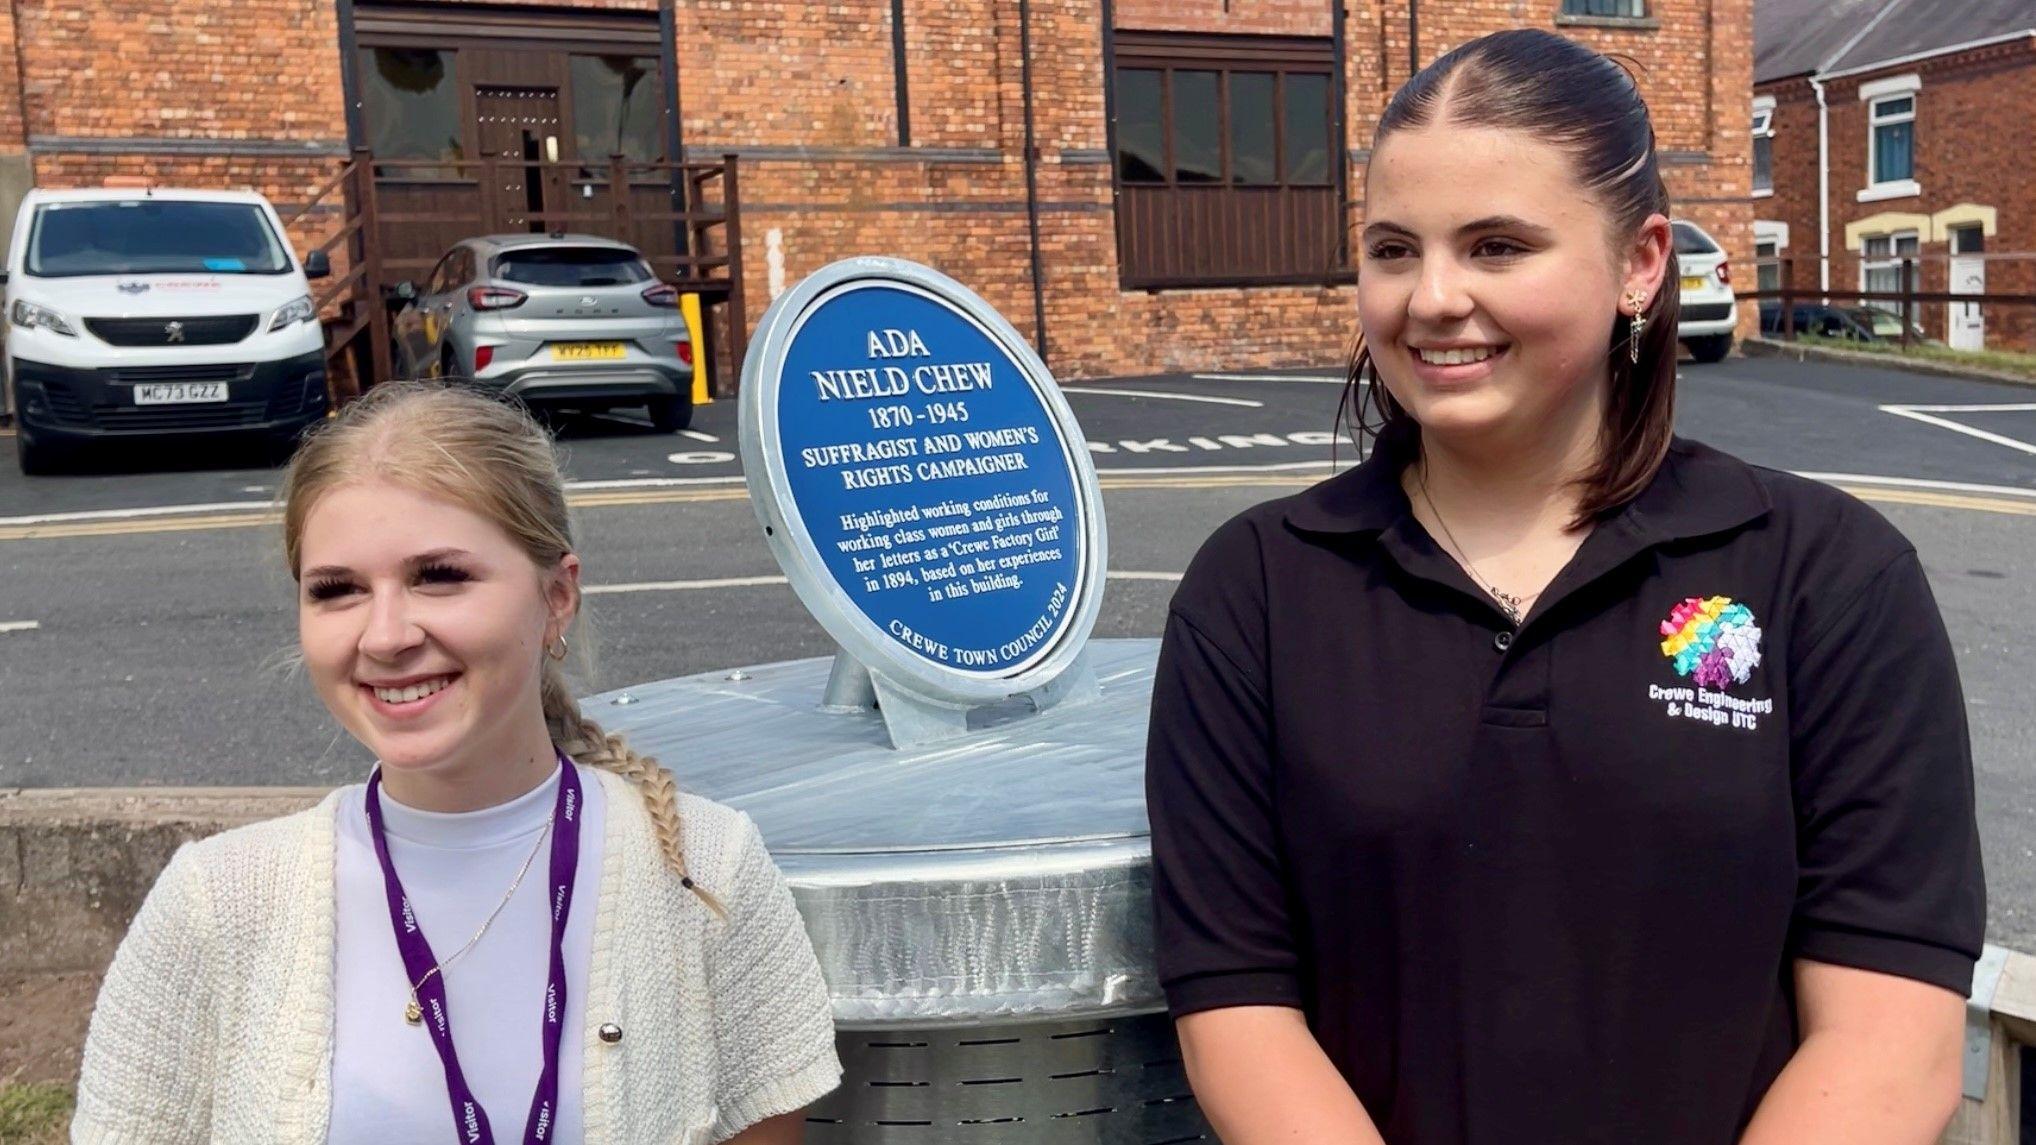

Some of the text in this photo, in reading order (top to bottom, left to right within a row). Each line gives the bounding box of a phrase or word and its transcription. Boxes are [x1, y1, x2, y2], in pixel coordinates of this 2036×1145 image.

[867, 329, 930, 359] ADA
[810, 362, 993, 401] NIELD CHEW
[800, 426, 1040, 468] SUFFRAGIST AND WOMEN'S
[841, 452, 1029, 490] RIGHTS CAMPAIGNER
[837, 506, 1064, 553] working class women and girls through
[840, 489, 1049, 532] Highlighted working conditions for
[853, 557, 877, 573] her
[880, 550, 922, 569] letters
[923, 547, 939, 560] as
[991, 530, 1034, 550] Factory
[865, 548, 1063, 592] in 1894, based on her experiences
[928, 574, 1024, 602] in this building.
[889, 582, 1068, 666] CREWE TOWN COUNCIL 2024
[1649, 684, 1773, 714] Crewe Engineering
[1667, 702, 1757, 731] & Design UTC
[564, 787, 577, 822] Visitor
[400, 895, 417, 934] Visitor
[555, 884, 567, 922] Visitor
[547, 982, 558, 1024] Visitor
[463, 1100, 481, 1144] Visitor
